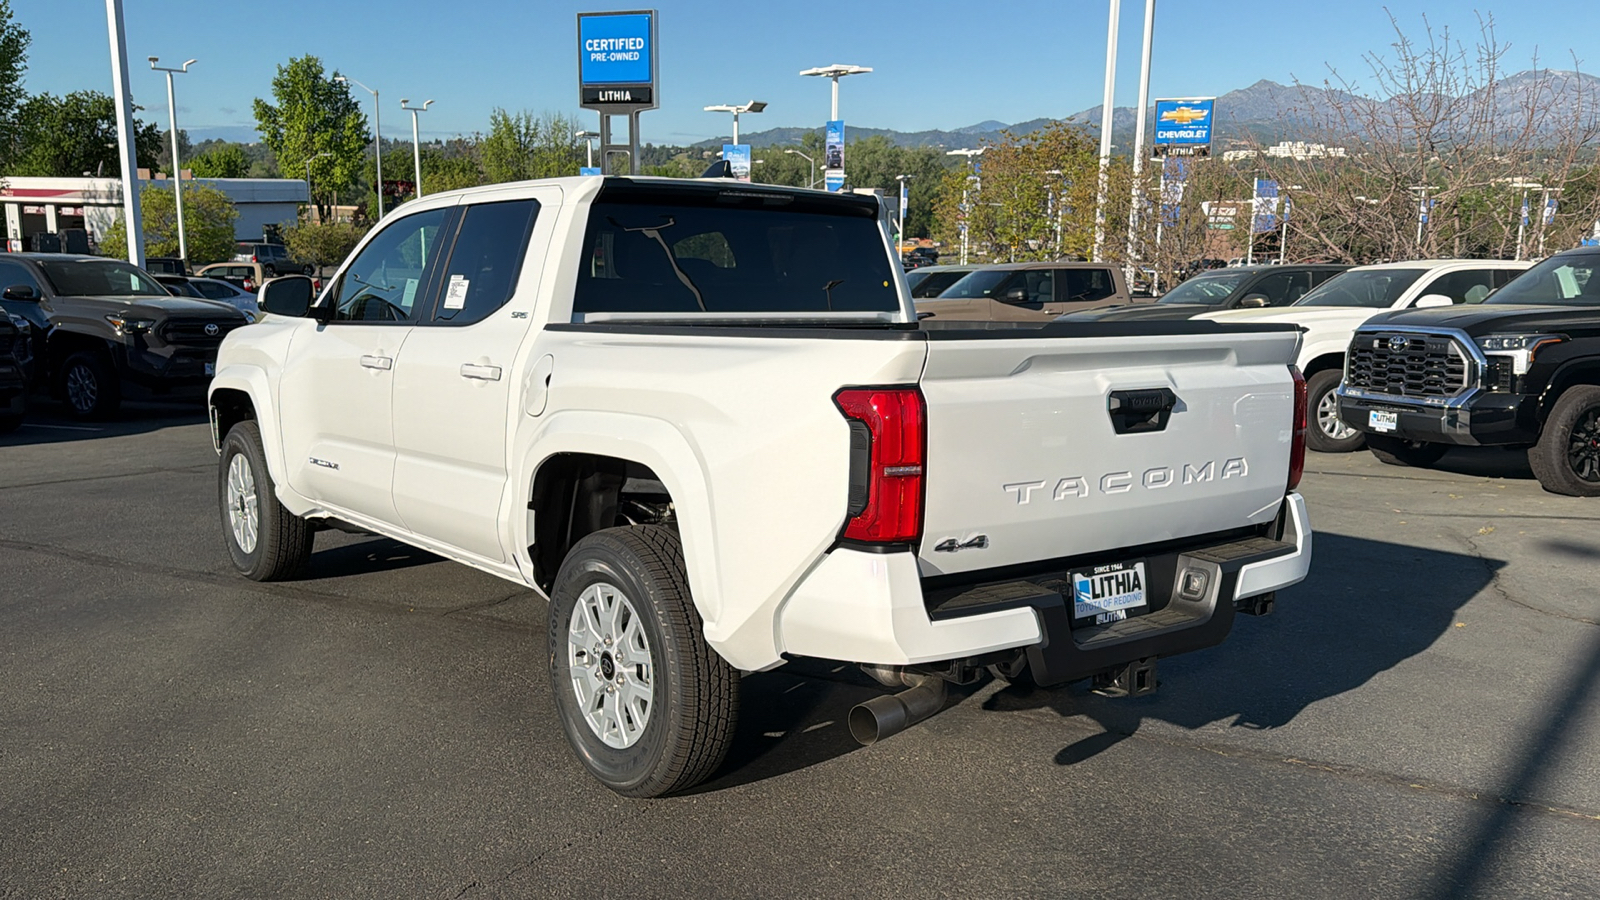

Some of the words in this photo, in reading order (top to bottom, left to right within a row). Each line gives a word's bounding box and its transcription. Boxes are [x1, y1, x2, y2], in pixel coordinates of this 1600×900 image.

[586, 37, 644, 51] CERTIFIED
[590, 51, 640, 62] PRE-OWNED
[599, 90, 632, 102] LITHIA
[1157, 130, 1208, 139] CHEVROLET
[1168, 147, 1194, 156] LITHIA
[1131, 396, 1161, 407] TOYOTA
[1376, 414, 1396, 424] LITHIA
[1003, 457, 1249, 505] TACOMA
[1094, 565, 1110, 574] SINCE
[1091, 571, 1142, 600] LITHIA
[1076, 601, 1102, 613] TOYOTA
[1103, 599, 1112, 608] OF
[1114, 592, 1142, 606] REDDING
[1103, 609, 1127, 622] LITHIA
